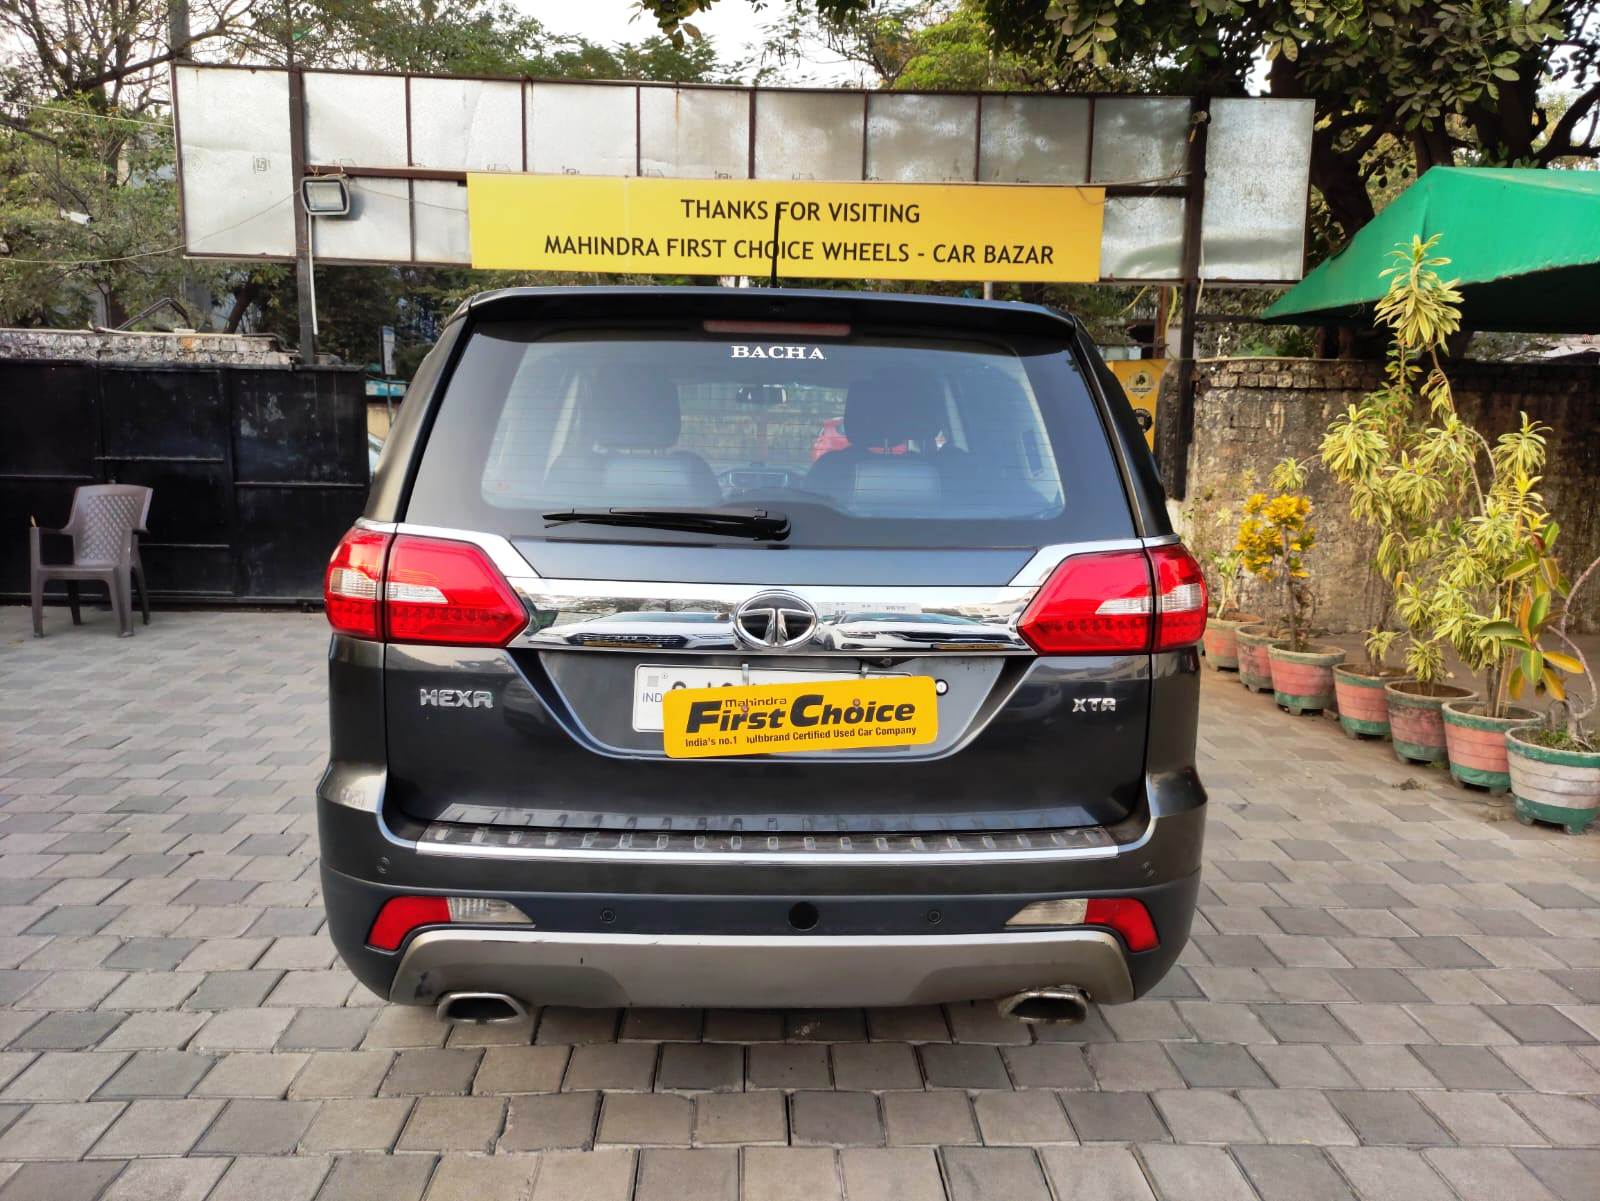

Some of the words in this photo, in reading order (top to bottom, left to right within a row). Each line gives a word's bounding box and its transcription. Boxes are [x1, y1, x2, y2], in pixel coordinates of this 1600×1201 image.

[680, 199, 769, 220] THANKS
[776, 201, 820, 221] FOR
[828, 202, 921, 223] VISITING
[544, 235, 660, 256] MAHINDRA
[667, 238, 727, 258] FIRST
[734, 240, 814, 260] CHOICE
[822, 242, 909, 262] WHEELS
[933, 244, 975, 263] CAR
[983, 245, 1054, 264] BAZAR
[731, 345, 825, 360] BACHA
[419, 688, 493, 708] HEXA
[642, 692, 663, 703] IND
[725, 697, 787, 708] Mahindra
[685, 700, 786, 733] First
[789, 694, 916, 727] Choice
[685, 737, 716, 747] India's
[719, 736, 737, 745] no.1
[792, 730, 831, 741] Certified
[833, 728, 855, 738] Used
[858, 727, 873, 736] Car
[875, 727, 917, 736] Company
